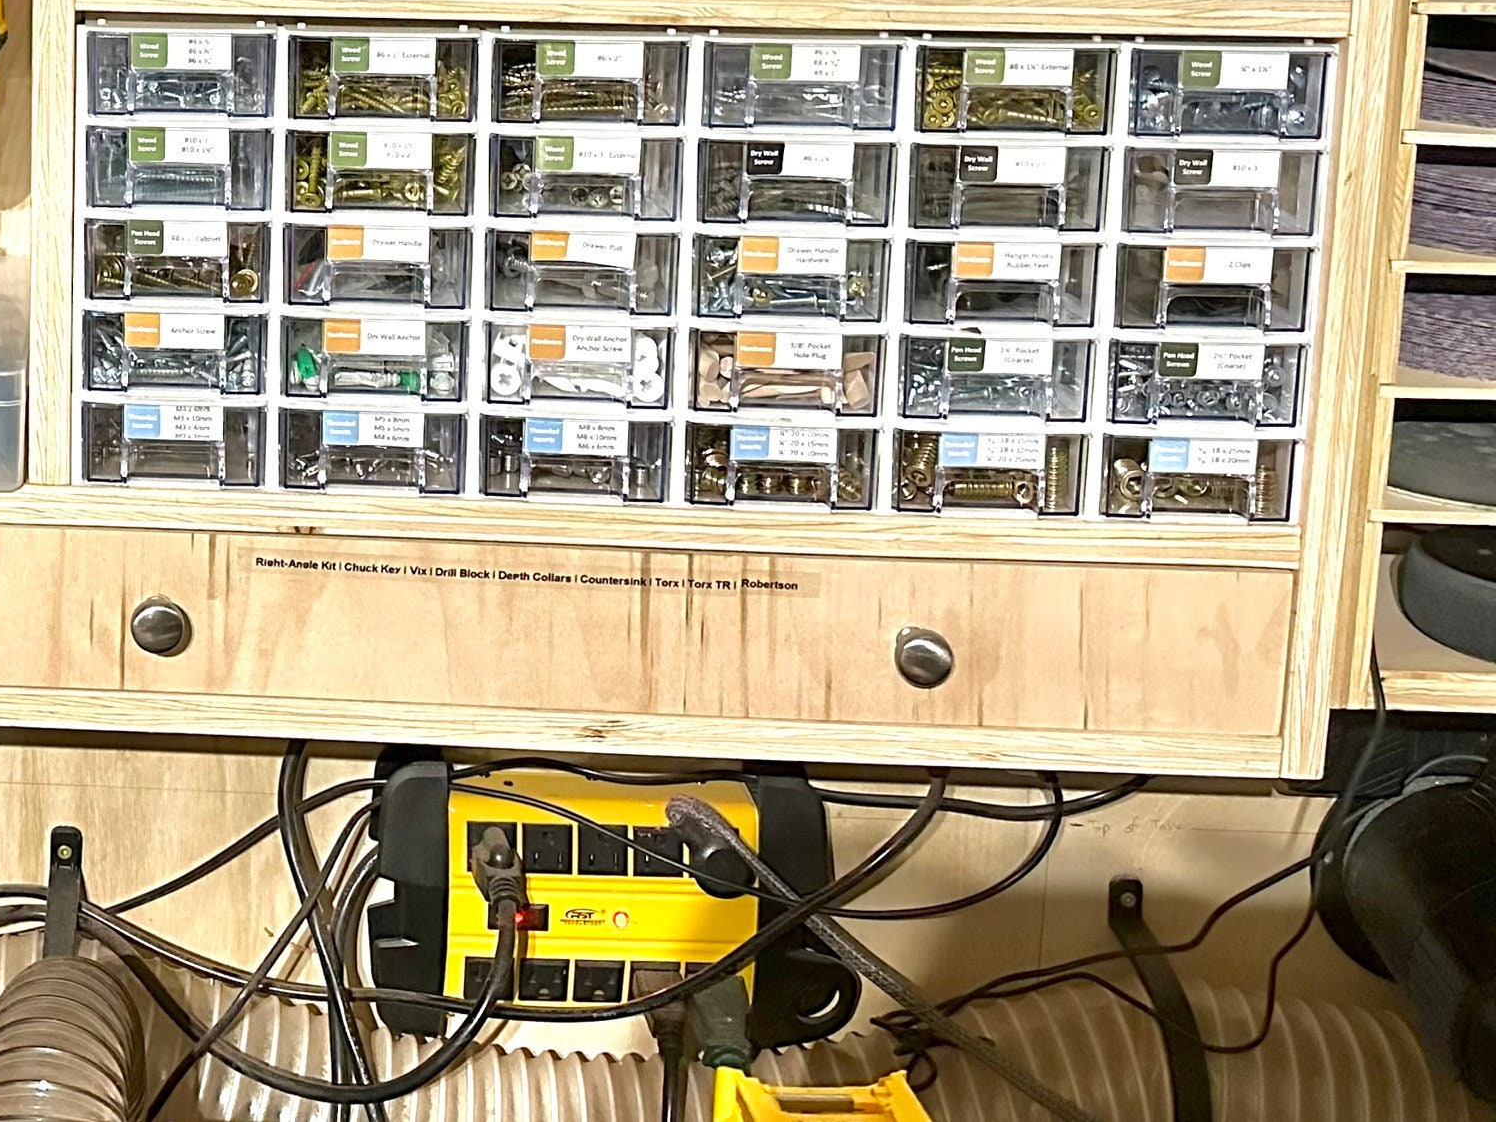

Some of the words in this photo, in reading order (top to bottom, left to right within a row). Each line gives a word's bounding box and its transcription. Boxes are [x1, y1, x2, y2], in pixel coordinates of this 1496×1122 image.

[751, 150, 761, 158] Dry
[583, 242, 607, 250] Drawer
[811, 352, 827, 360] Plug
[321, 561, 337, 571] Kit
[344, 562, 378, 574] Chuck
[380, 564, 400, 575] Key
[410, 566, 427, 576] Vix
[435, 567, 457, 578] Drill
[460, 569, 490, 579] Block
[533, 572, 571, 583] Collars
[580, 575, 647, 586] Countersink
[655, 578, 679, 588] Torx
[689, 579, 712, 589] Torx
[716, 581, 731, 590] TR
[741, 579, 798, 590] Robertson
